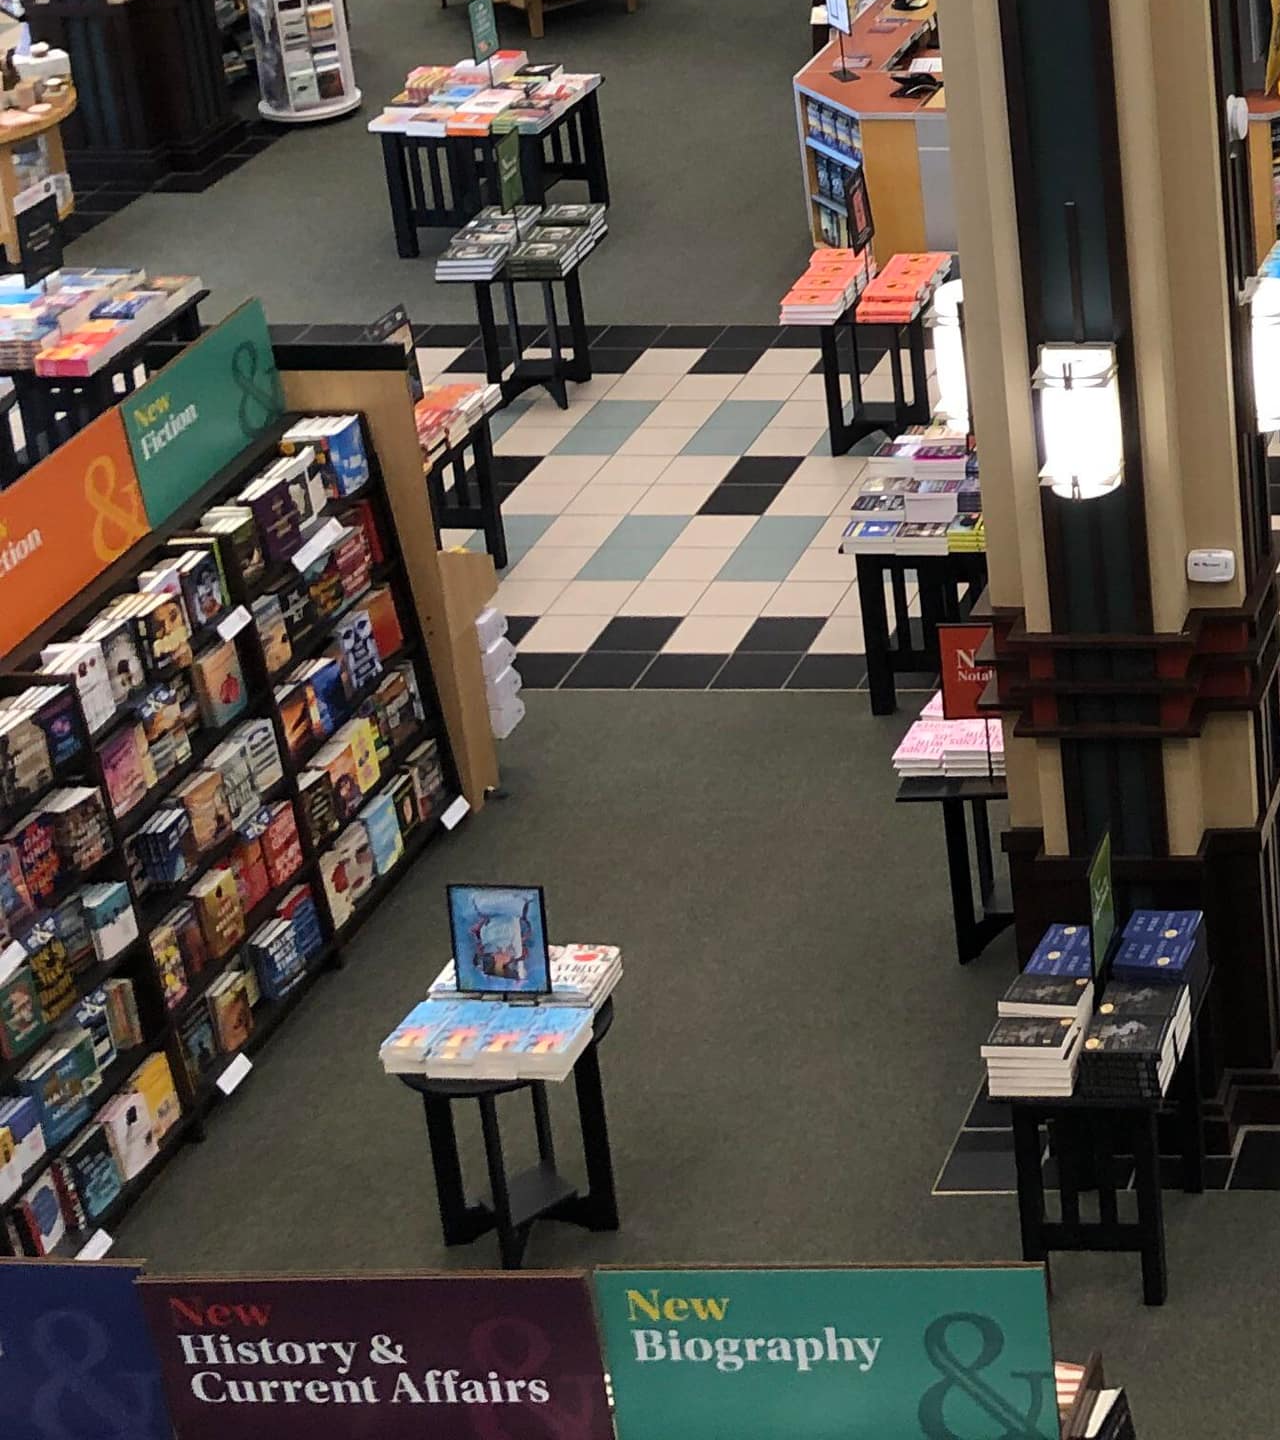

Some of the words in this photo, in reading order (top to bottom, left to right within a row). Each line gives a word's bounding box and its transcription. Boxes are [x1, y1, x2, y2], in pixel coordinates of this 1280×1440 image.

[133, 392, 171, 428] New
[140, 401, 200, 460] Fiction
[170, 1296, 271, 1328] New
[626, 1289, 729, 1323] New
[179, 1332, 357, 1372] History
[369, 1334, 405, 1366] &
[634, 1328, 882, 1372] Biography
[190, 1370, 383, 1406] Current
[392, 1369, 550, 1407] Affairs
